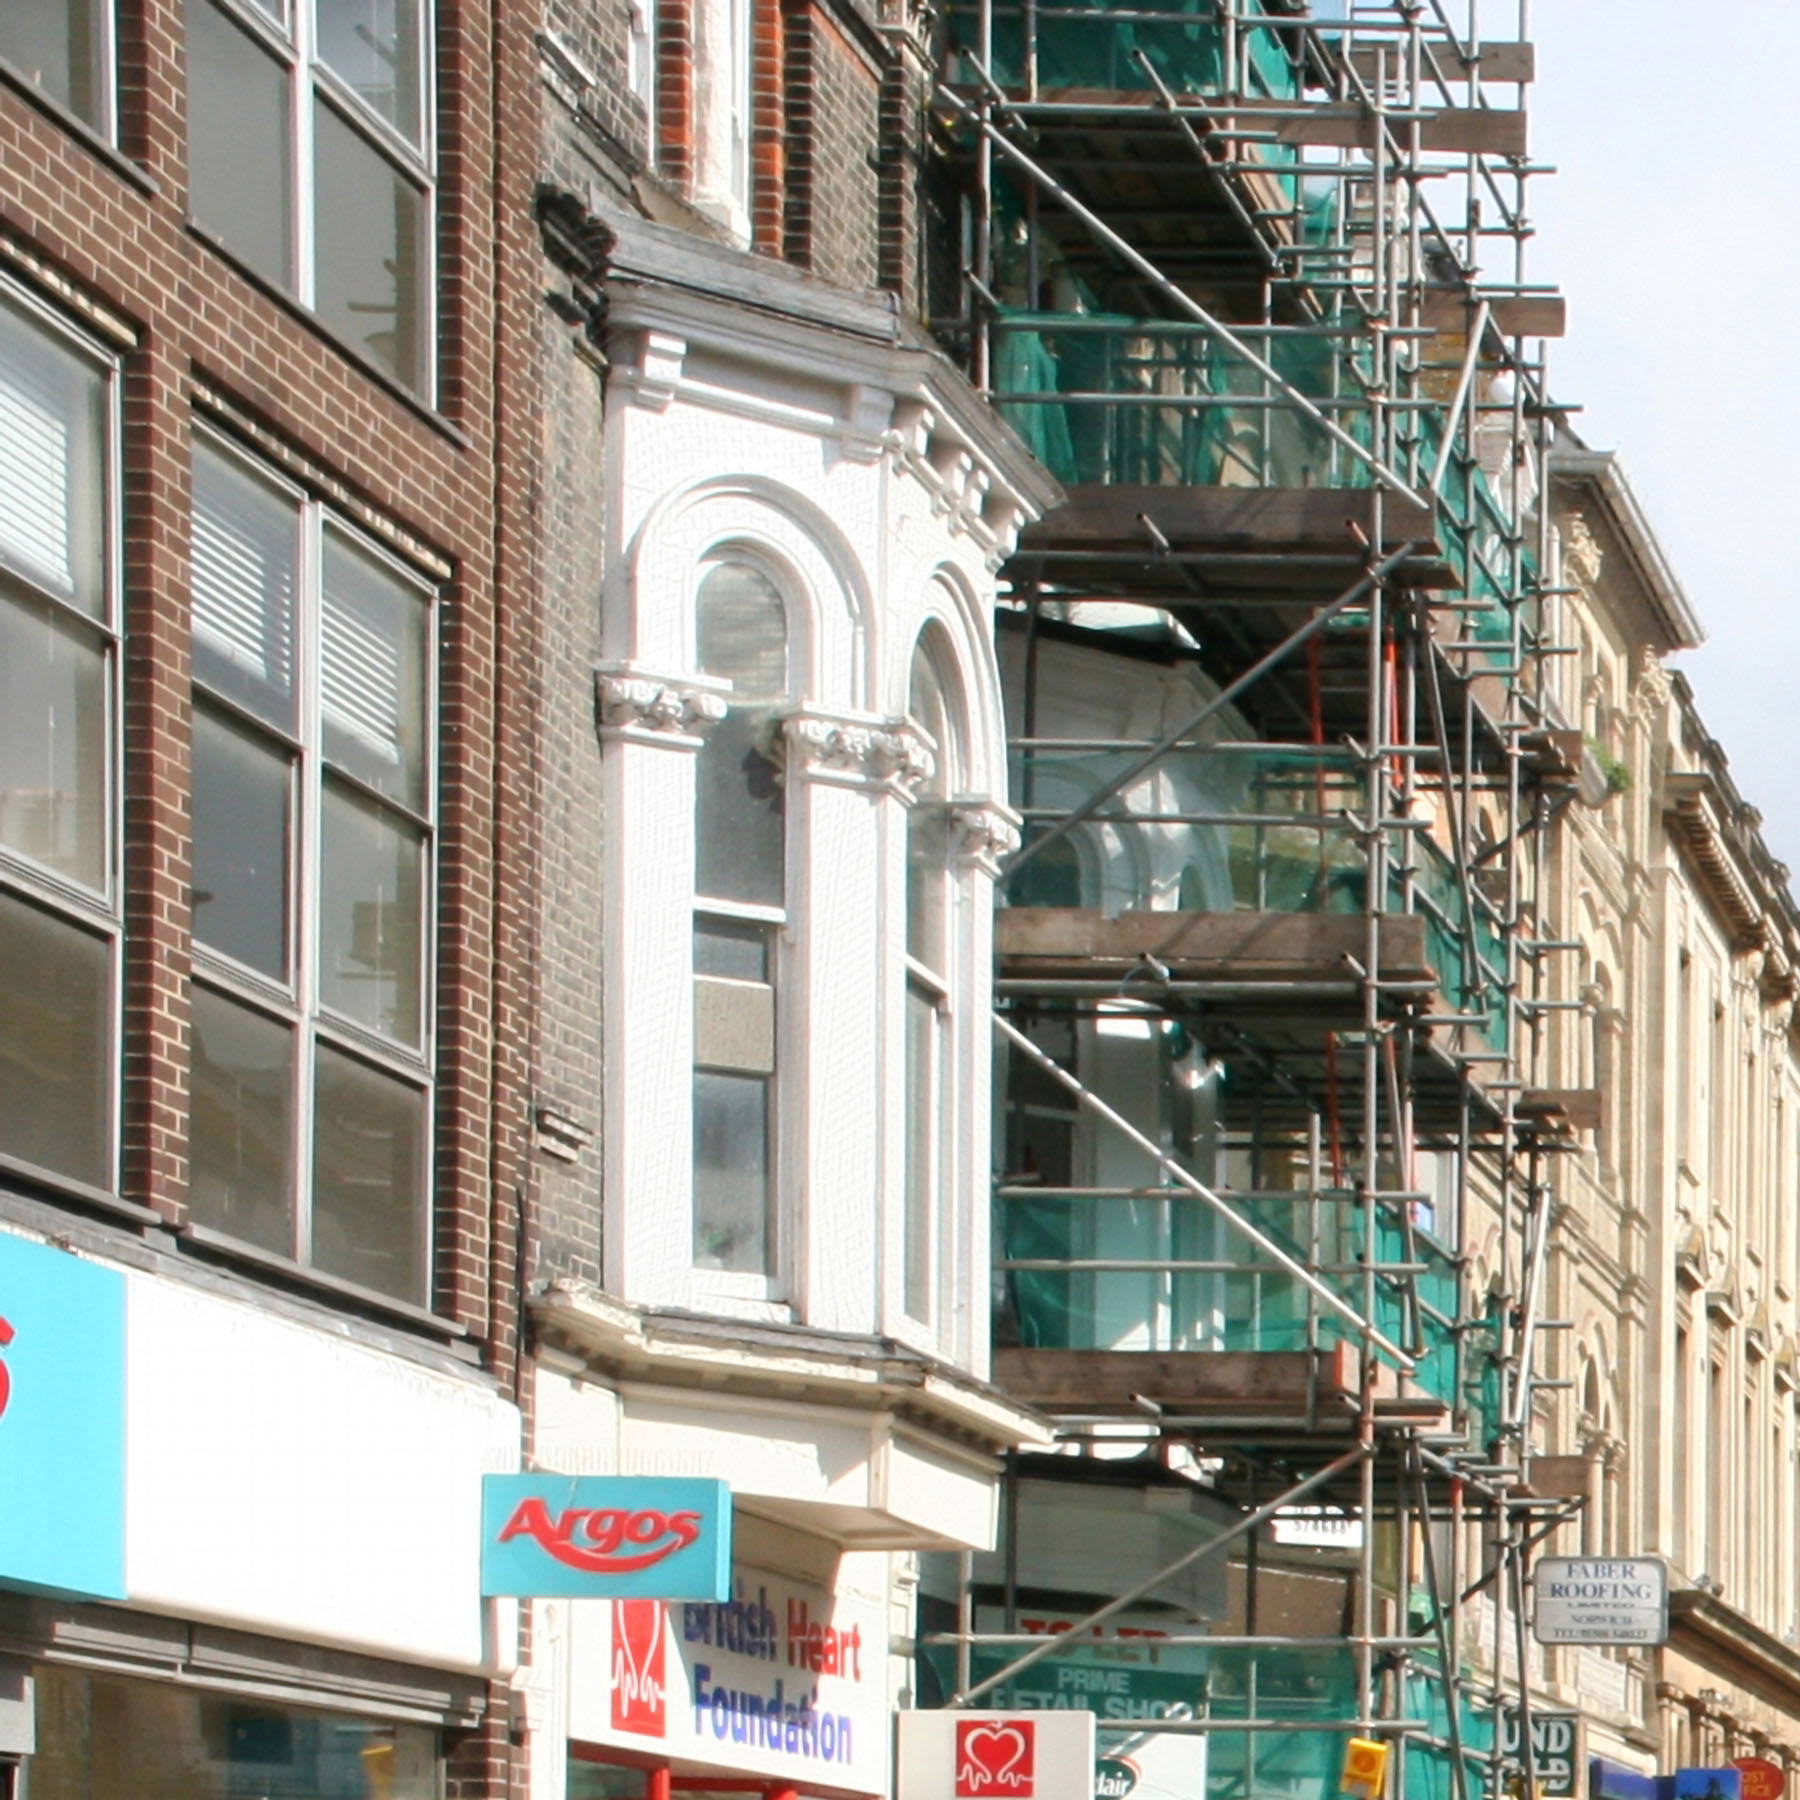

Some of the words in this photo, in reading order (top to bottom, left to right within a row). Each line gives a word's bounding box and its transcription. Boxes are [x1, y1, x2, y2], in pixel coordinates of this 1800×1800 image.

[497, 1495, 703, 1556] Argos
[1567, 1563, 1635, 1579] FABER
[1550, 1583, 1652, 1599] ROOFING
[787, 1597, 861, 1684] Heart
[1057, 1667, 1131, 1695] PRIME
[693, 1663, 853, 1767] Foundation
[1741, 1770, 1766, 1782] OST
